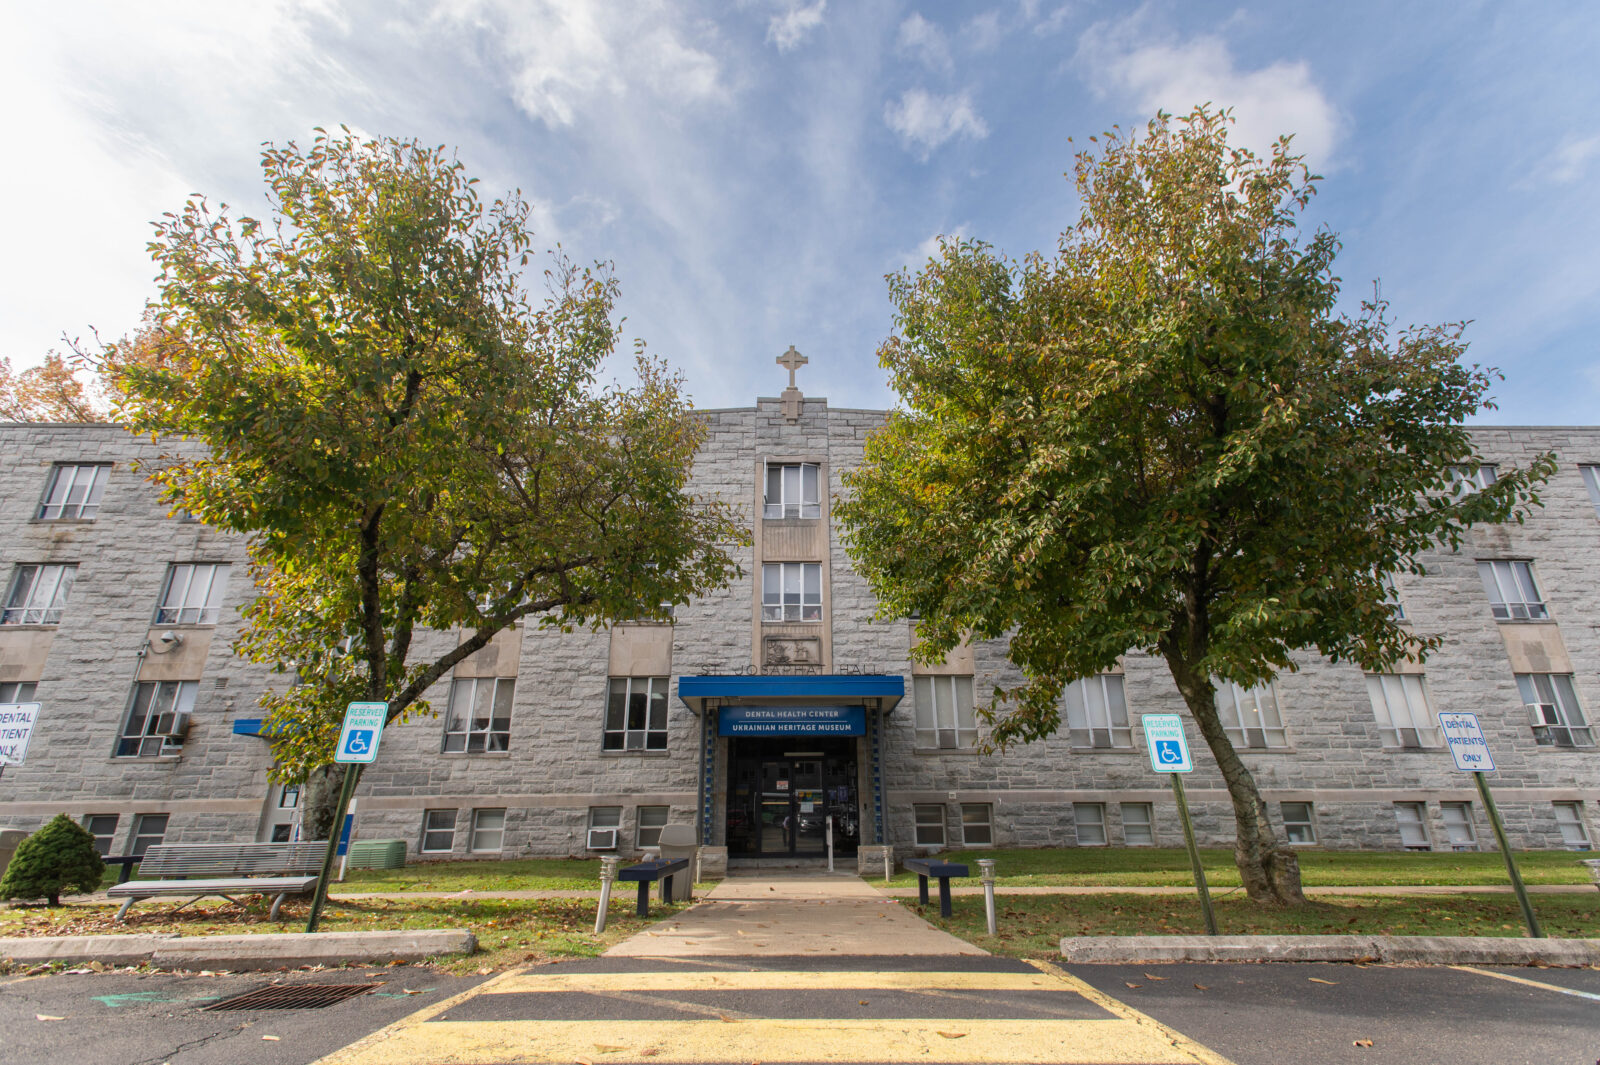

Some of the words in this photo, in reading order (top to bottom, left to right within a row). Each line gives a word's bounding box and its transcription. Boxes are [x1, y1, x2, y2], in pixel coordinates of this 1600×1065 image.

[839, 664, 882, 676] HALL
[350, 708, 384, 717] RESERVED
[350, 718, 379, 727] PARKING
[1146, 720, 1180, 728] RESERVED
[1445, 720, 1476, 729] DENTAL
[0, 728, 30, 739] TIENT
[1151, 729, 1180, 738] PARKING
[1448, 737, 1485, 746] PATIENTS
[1462, 753, 1482, 762] ONLY
